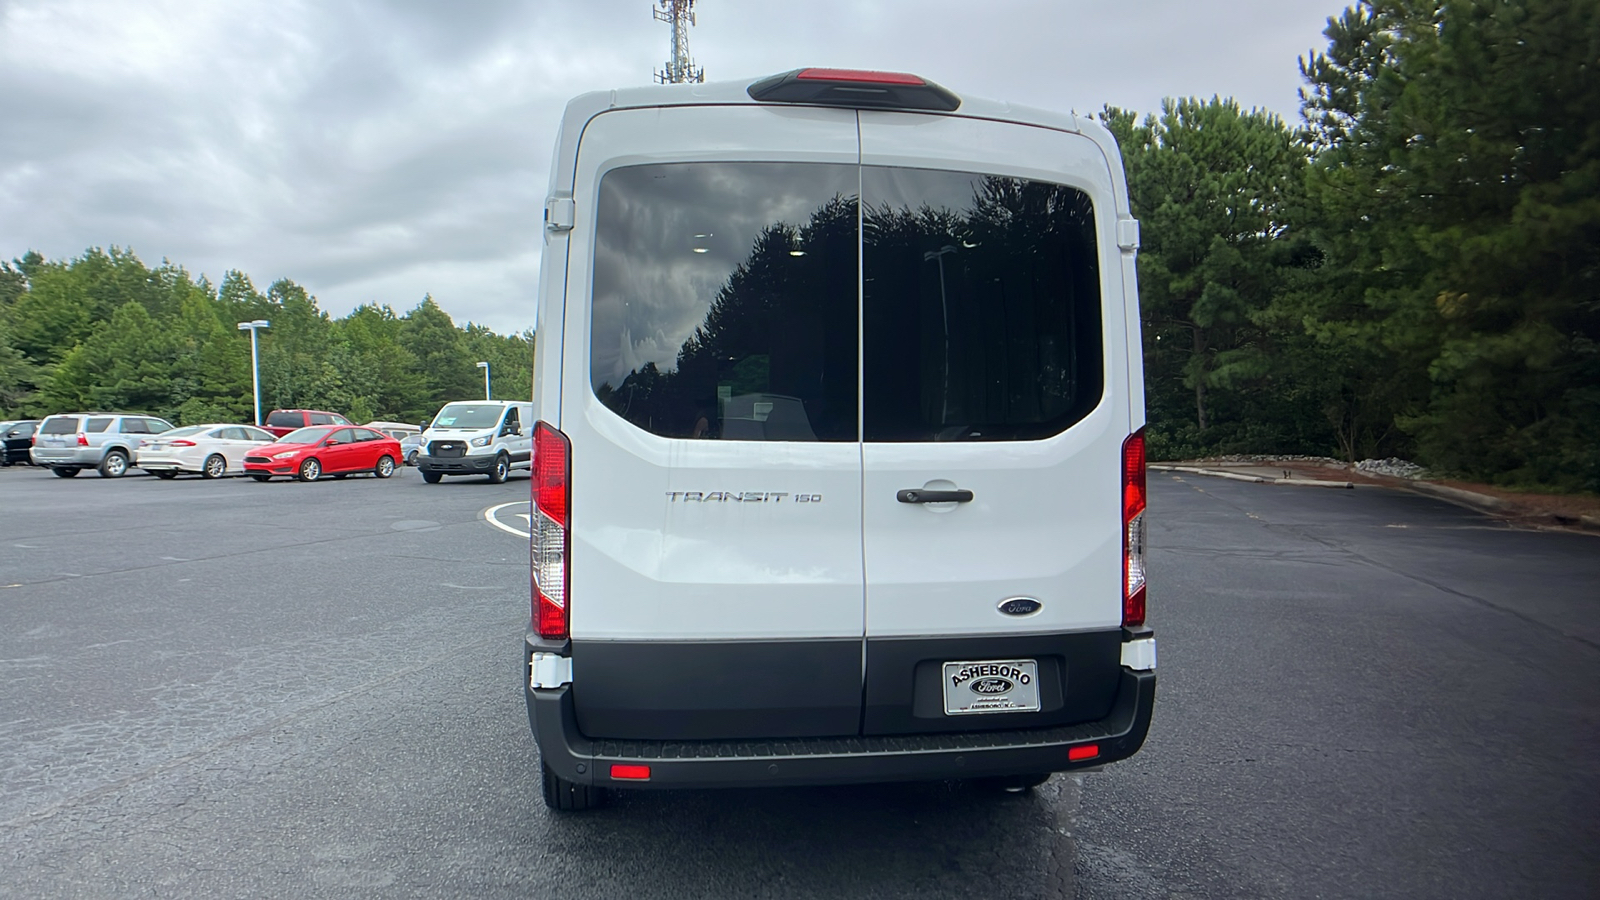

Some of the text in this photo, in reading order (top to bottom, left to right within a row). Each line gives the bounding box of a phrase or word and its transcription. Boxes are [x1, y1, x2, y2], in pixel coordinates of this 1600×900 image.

[665, 491, 822, 503] TRANSIT 150
[1008, 602, 1032, 613] Ford
[951, 665, 1031, 687] ASHEBORO
[978, 680, 1005, 692] Ford
